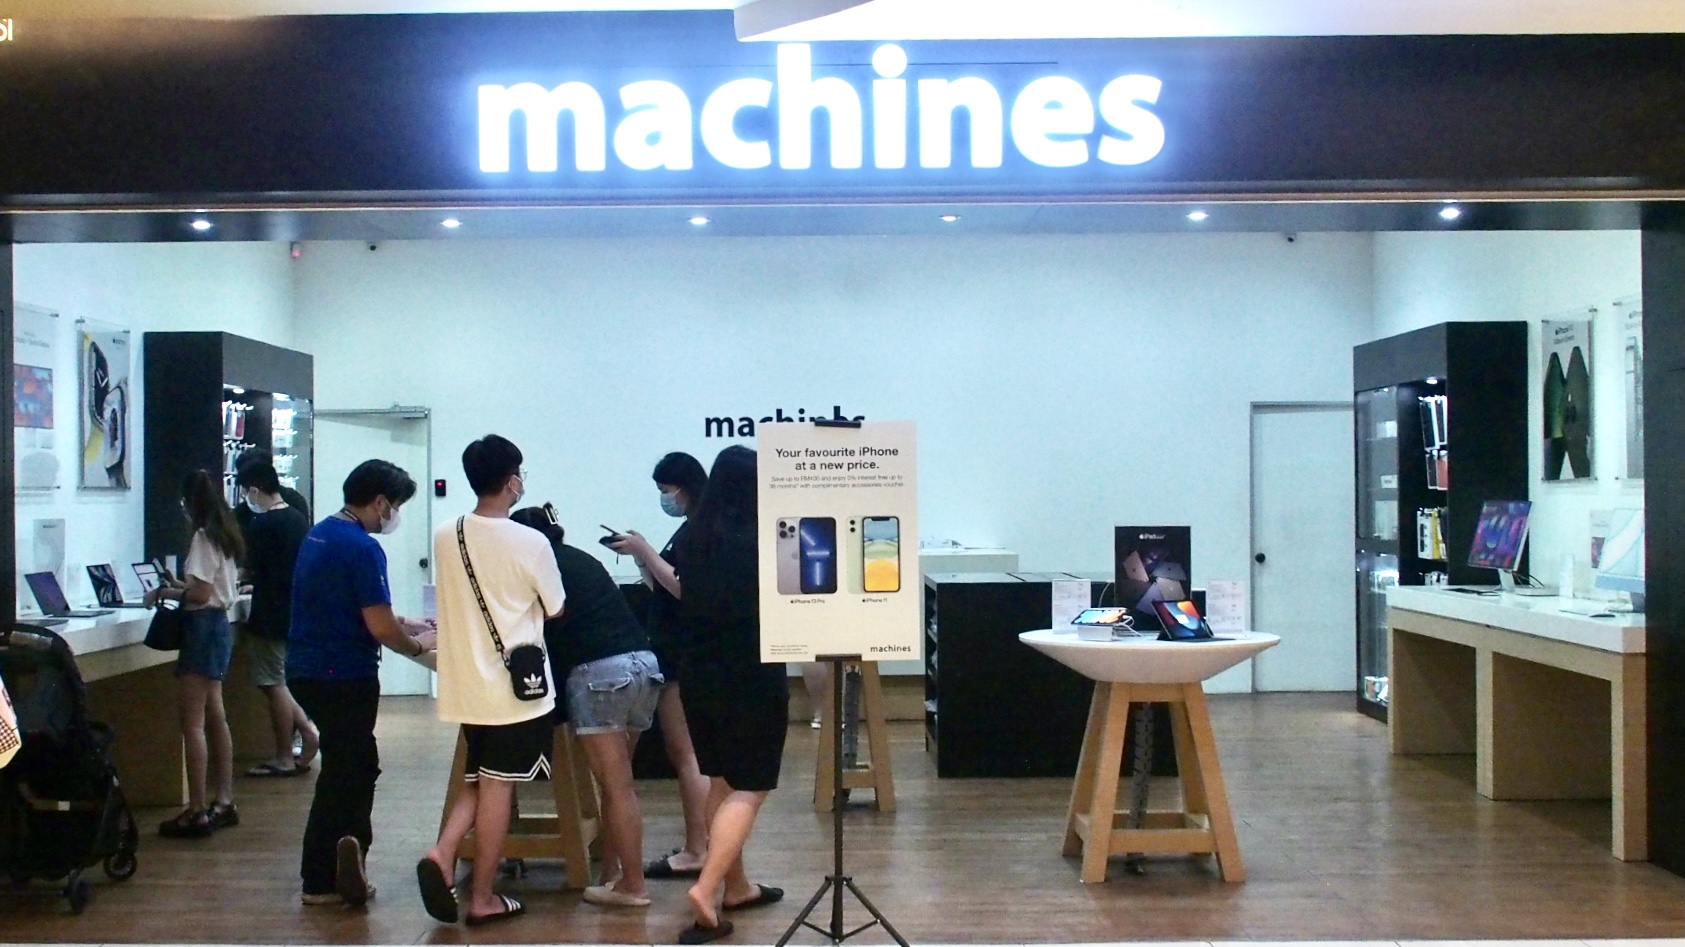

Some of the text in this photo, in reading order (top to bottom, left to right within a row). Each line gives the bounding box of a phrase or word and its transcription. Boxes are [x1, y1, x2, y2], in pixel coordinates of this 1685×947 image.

[478, 43, 1166, 172] machines
[775, 446, 899, 459] Your favourite iPhone
[795, 460, 880, 471] at a new price.
[870, 644, 911, 653] machines
